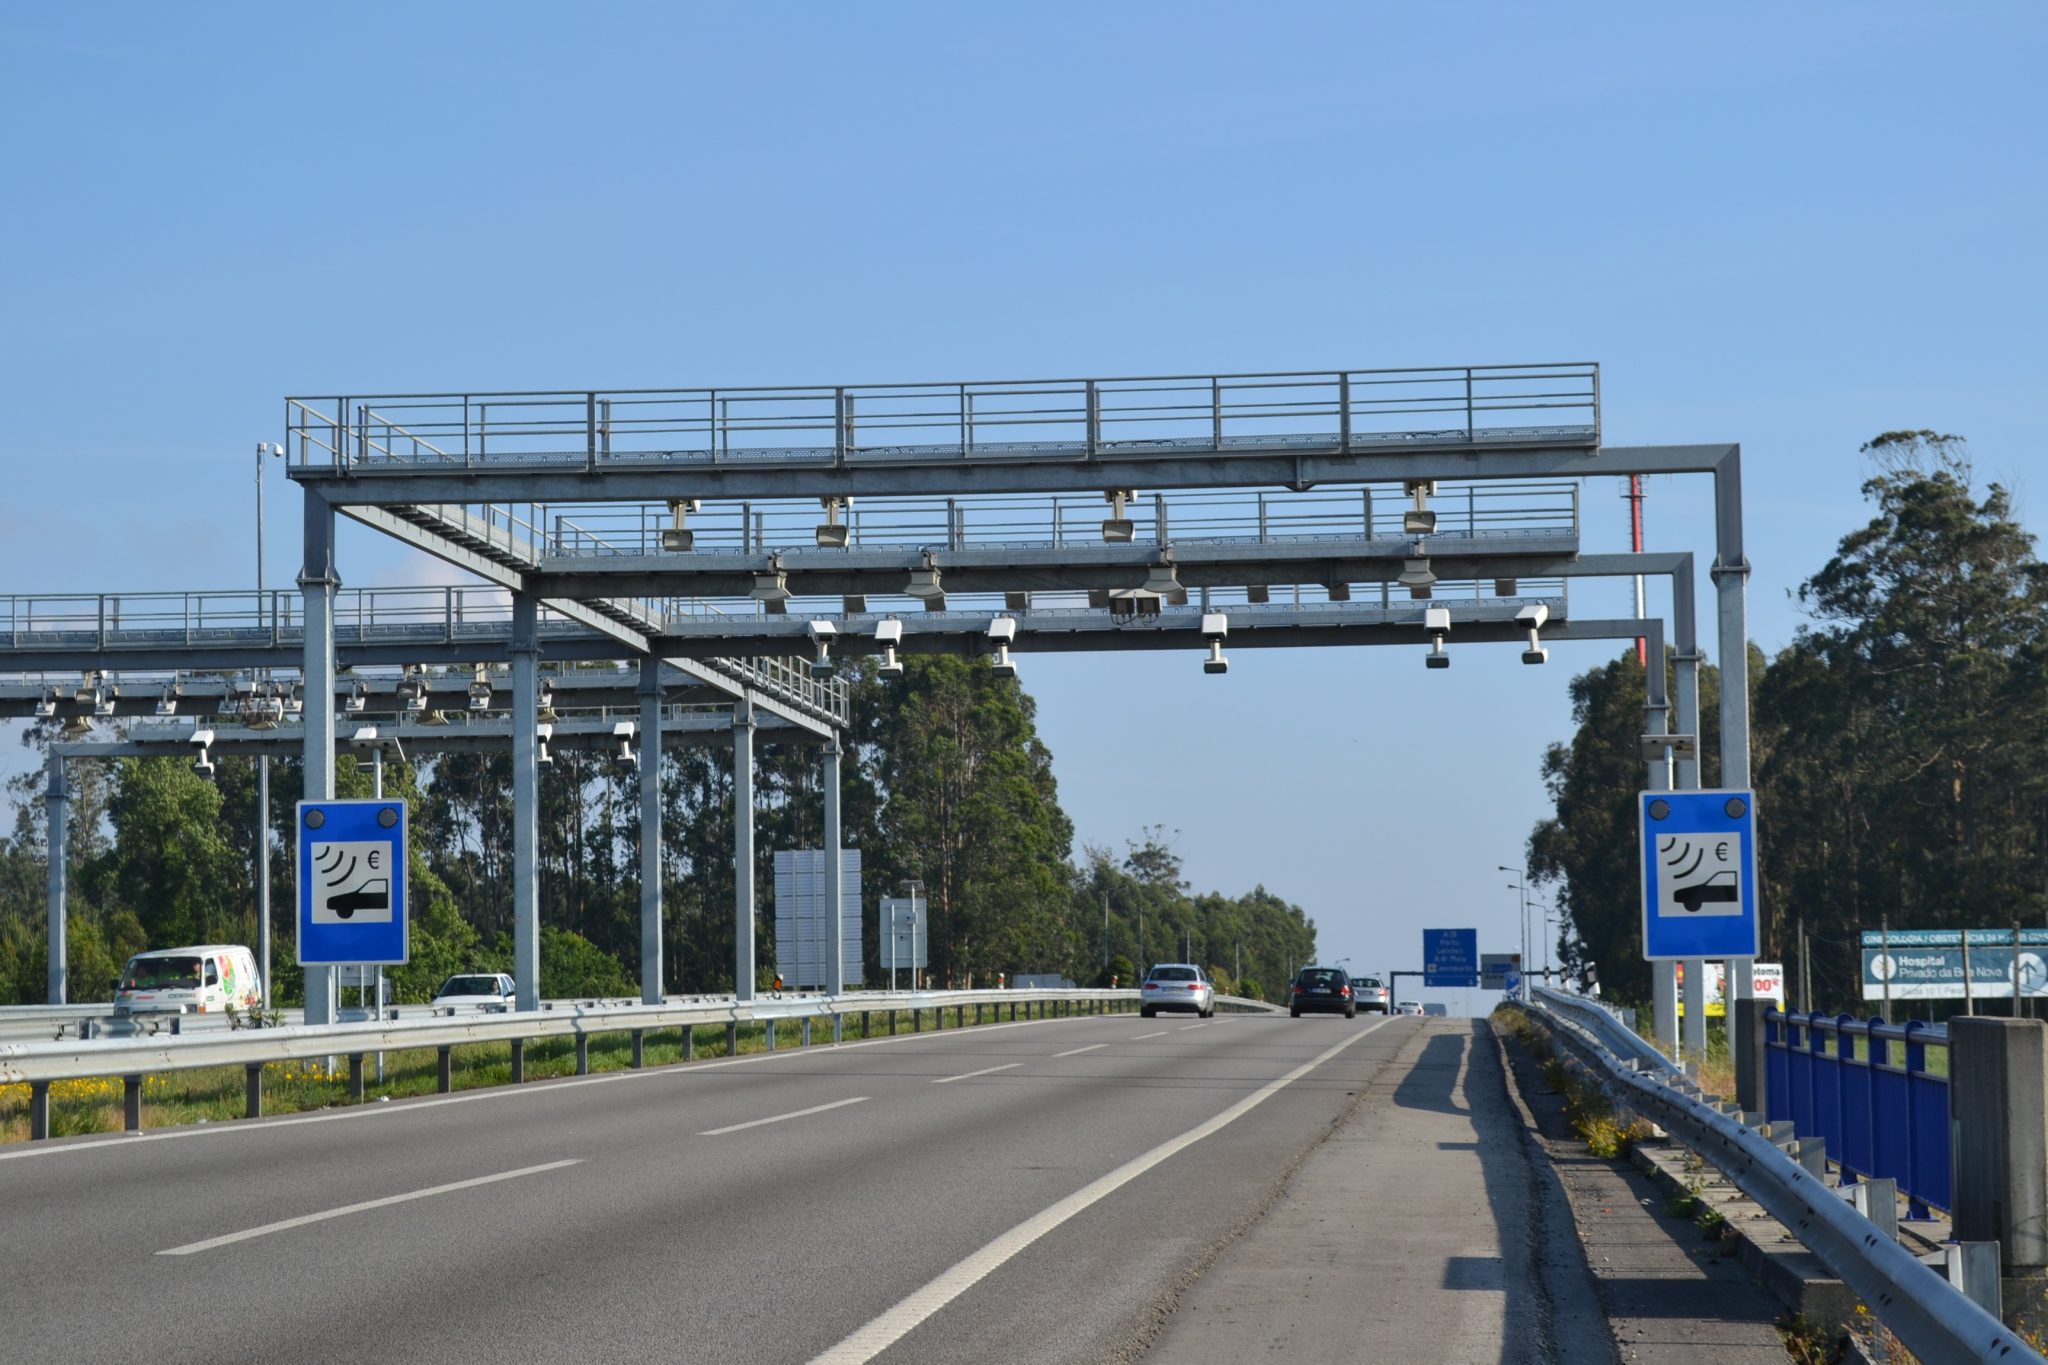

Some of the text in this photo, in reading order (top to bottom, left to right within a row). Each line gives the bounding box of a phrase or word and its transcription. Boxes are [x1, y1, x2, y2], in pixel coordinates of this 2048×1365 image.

[1898, 956, 1945, 968] Hospital
[1898, 967, 1936, 978] Privado
[1939, 967, 1952, 977] da
[1976, 966, 2003, 977] Nova
